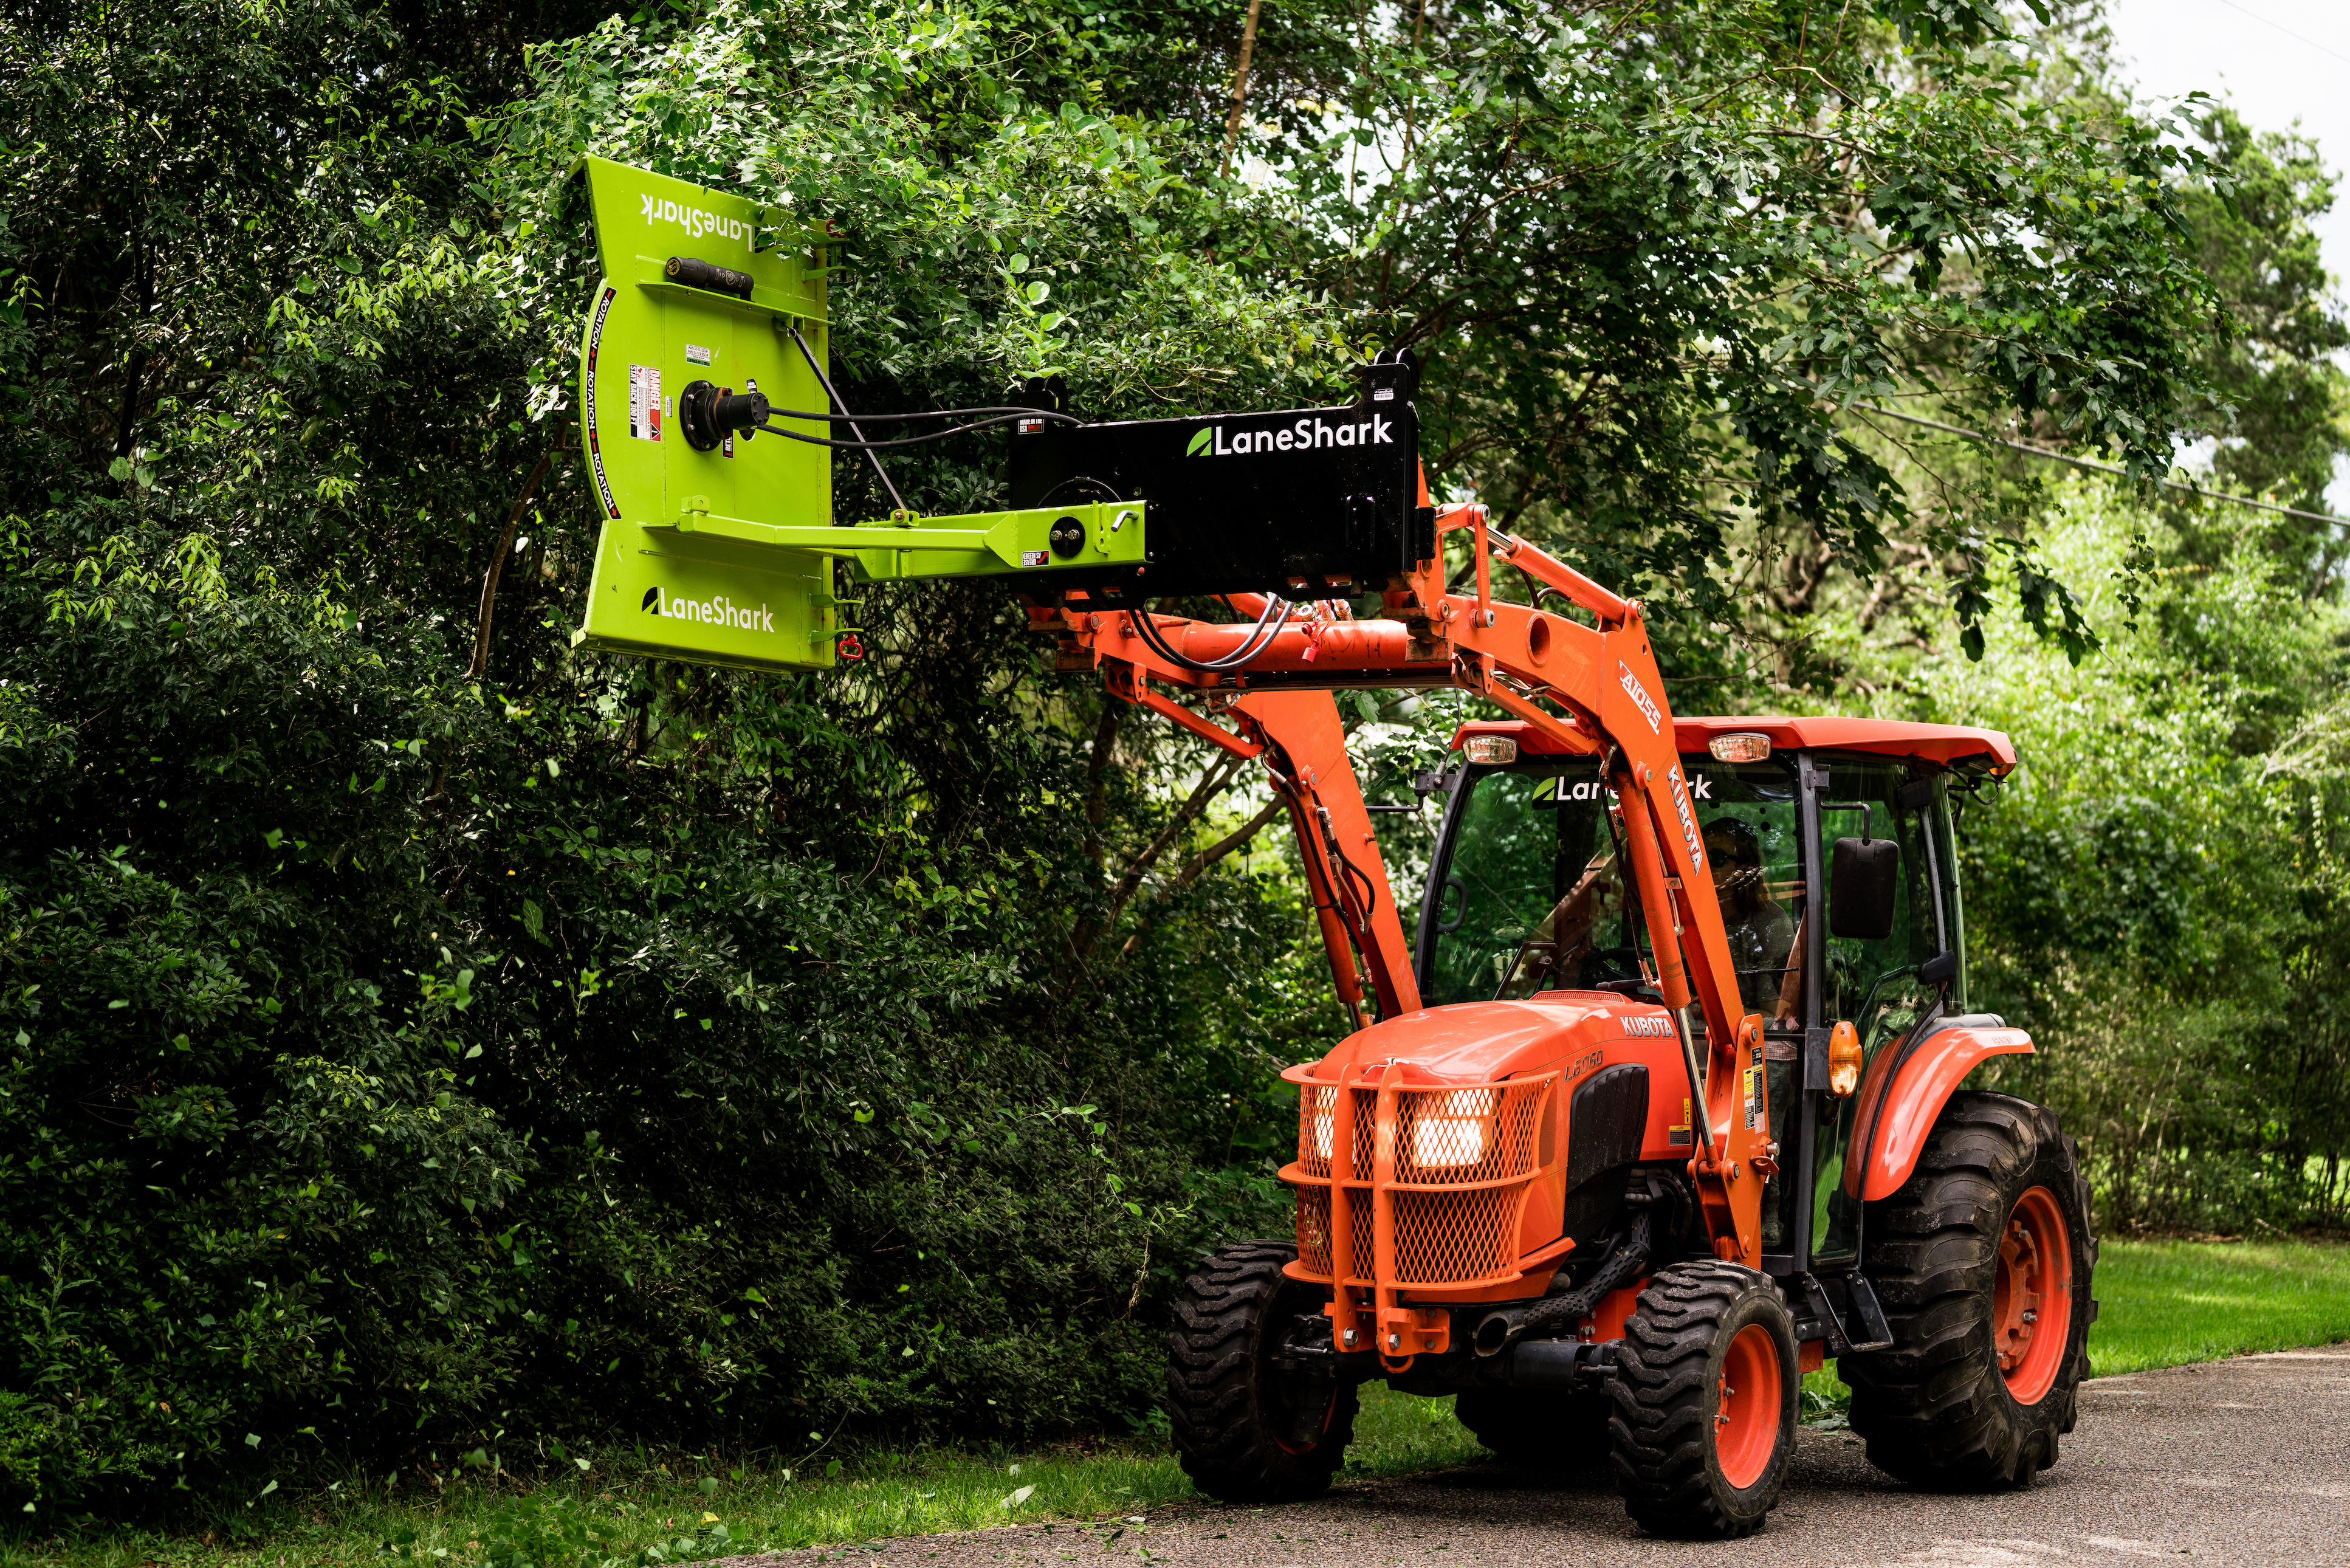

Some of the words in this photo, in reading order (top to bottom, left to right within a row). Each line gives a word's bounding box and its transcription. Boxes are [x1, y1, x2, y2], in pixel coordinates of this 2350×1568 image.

[641, 193, 752, 252] LaneShark
[591, 297, 610, 349] ROTATION
[650, 369, 660, 410] DANGER
[631, 417, 636, 425] FT
[1215, 413, 1393, 456] LaneShark
[593, 453, 614, 509] ROTATION
[660, 587, 775, 633] LaneShark
[1621, 673, 1661, 731] A1055
[1667, 763, 1702, 876] KUBOTA
[1620, 1016, 1676, 1037] KUBOTA
[1991, 1036, 2015, 1045] HST
[1565, 1049, 1603, 1082] L6060
